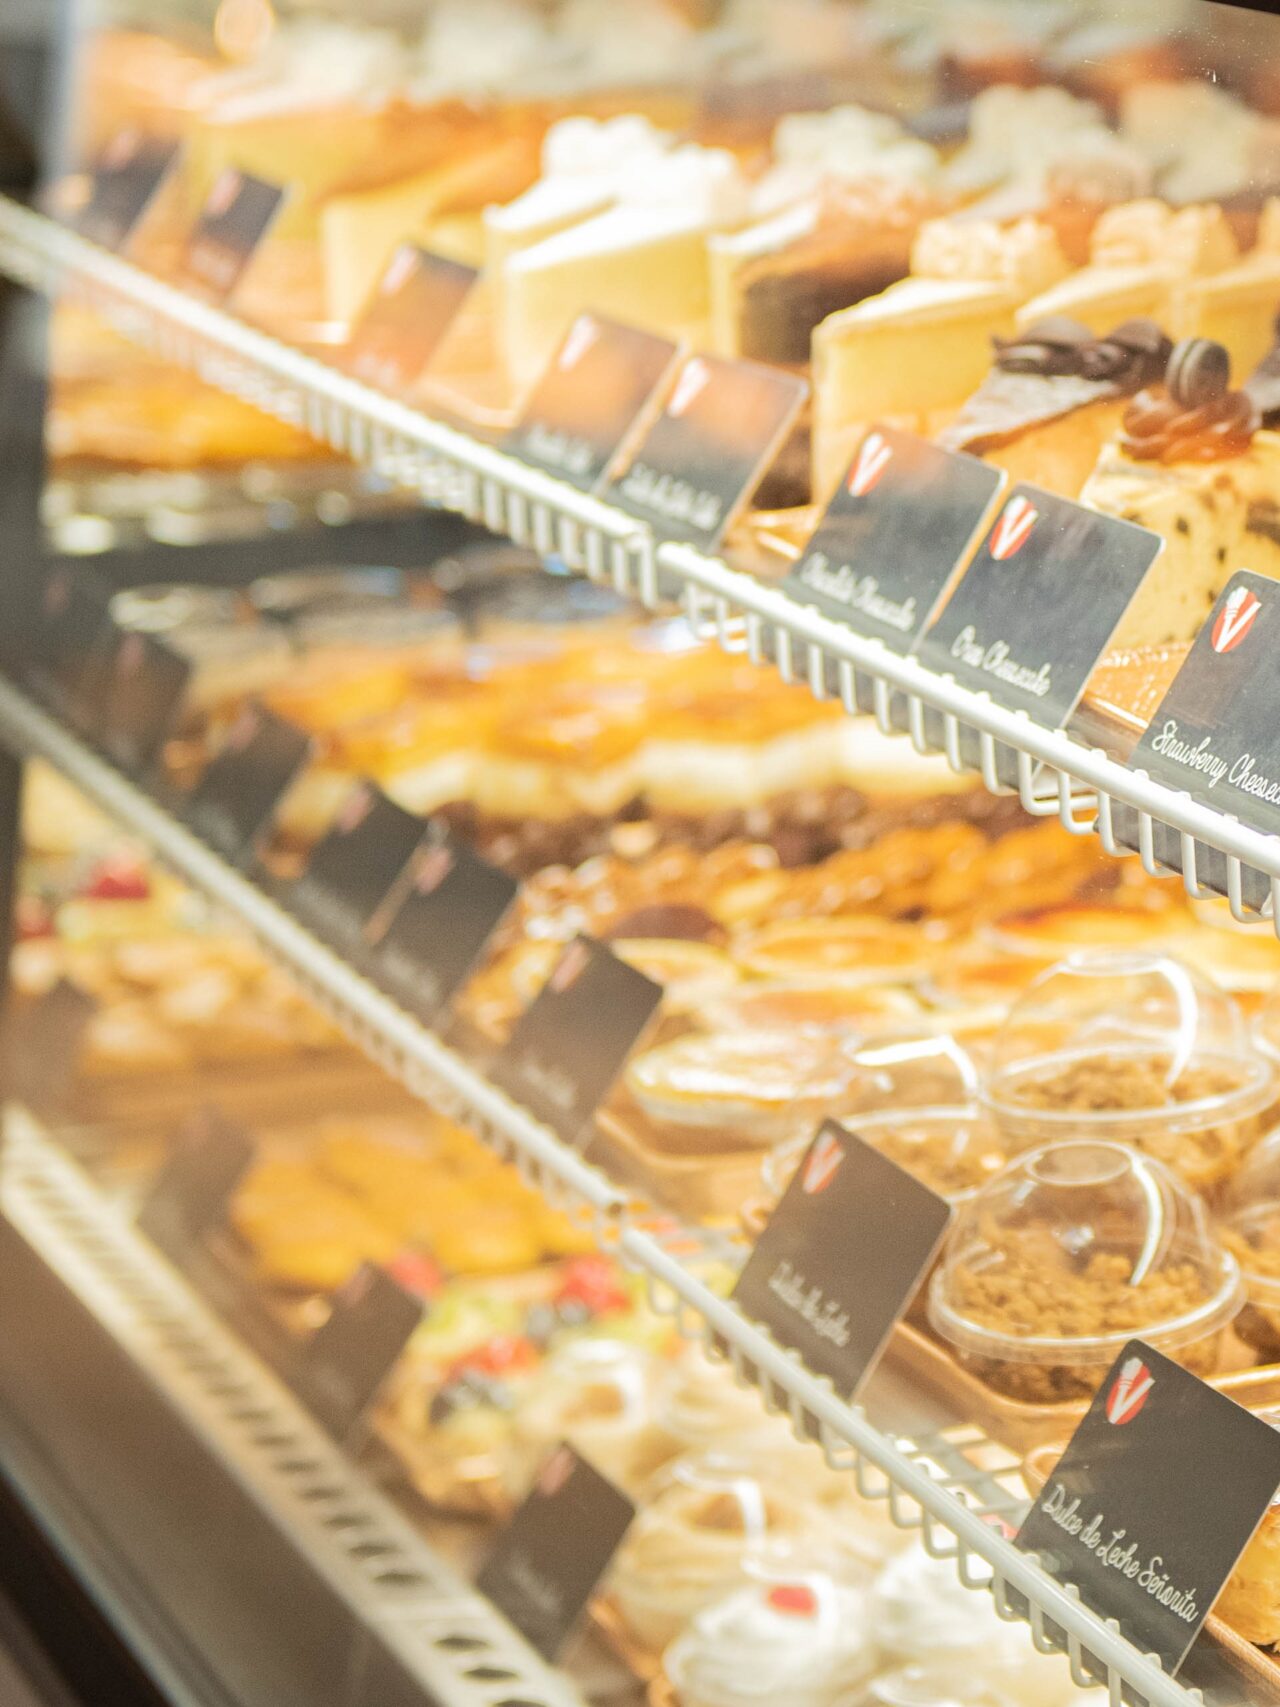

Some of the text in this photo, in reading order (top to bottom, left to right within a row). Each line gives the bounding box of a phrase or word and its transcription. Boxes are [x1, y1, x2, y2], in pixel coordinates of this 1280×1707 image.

[1151, 720, 1229, 788] Strawberry
[1041, 1484, 1199, 1623] Dulce de Leche Señorita
